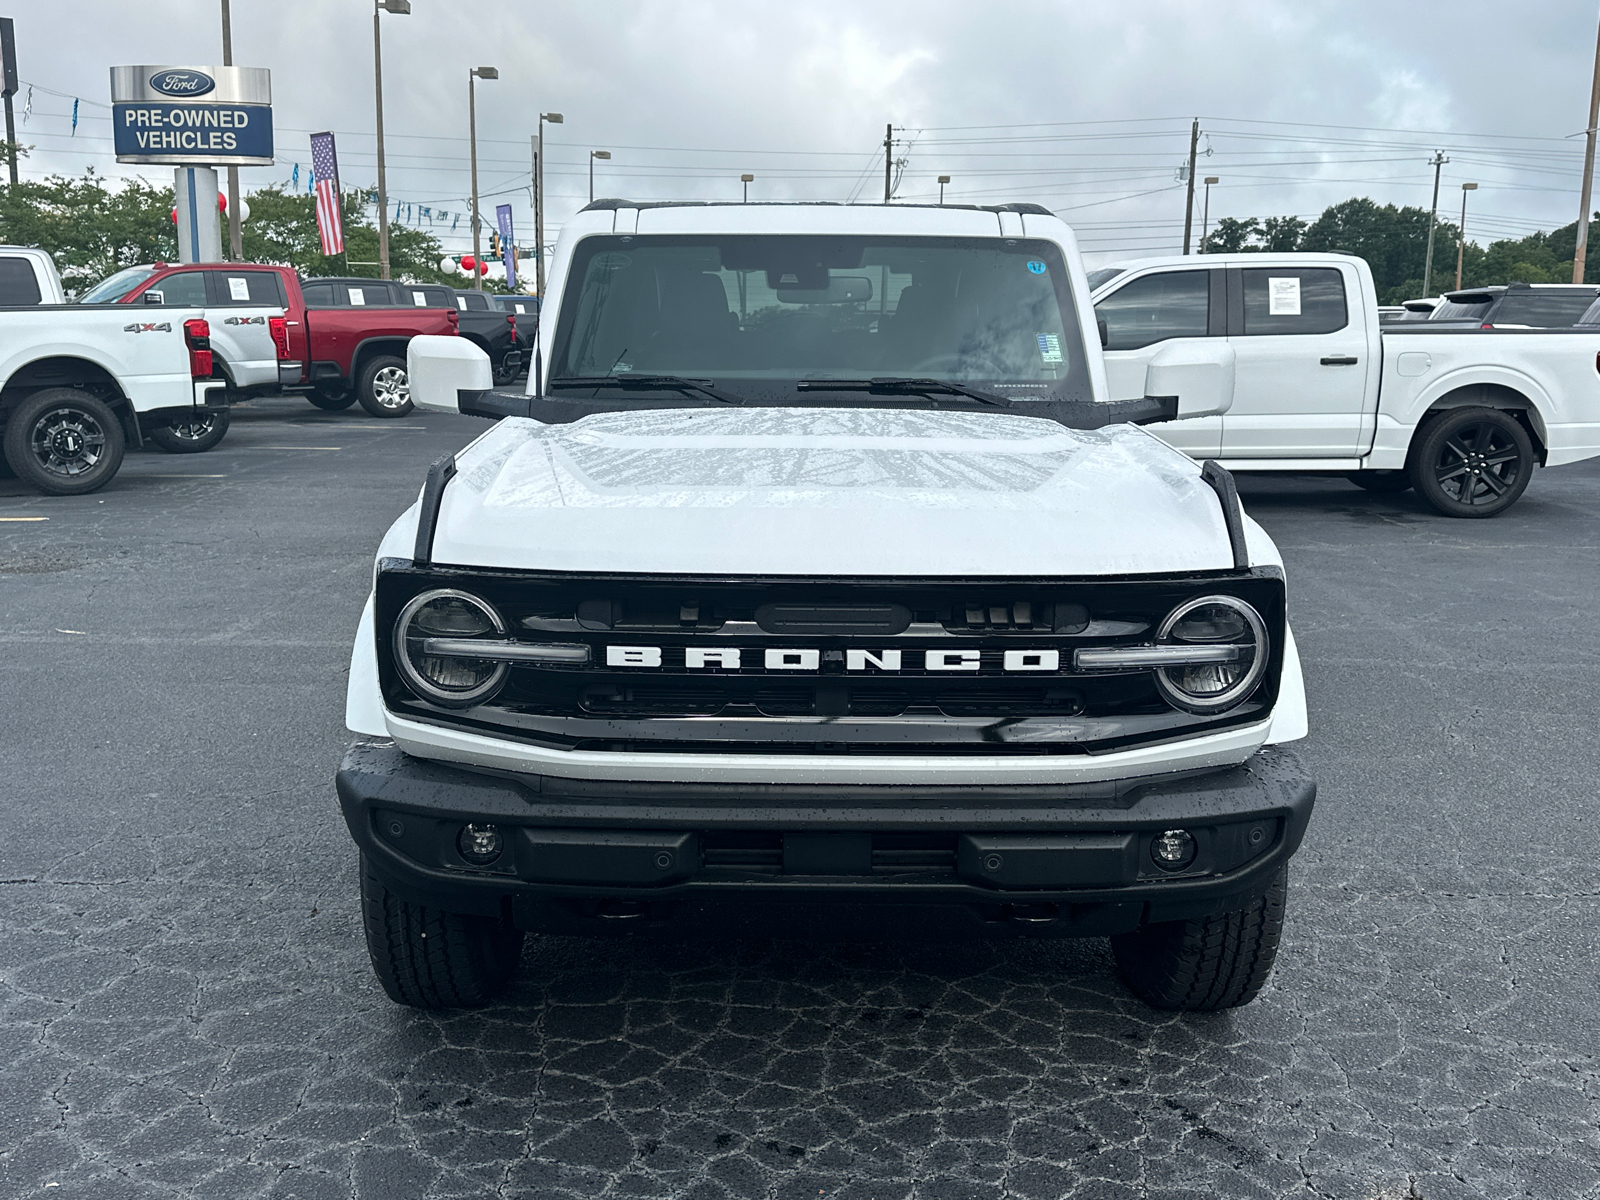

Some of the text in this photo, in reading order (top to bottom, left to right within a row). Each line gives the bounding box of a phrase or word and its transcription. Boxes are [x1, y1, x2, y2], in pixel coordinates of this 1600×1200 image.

[162, 74, 198, 91] Ford
[125, 109, 249, 128] PRE-OWNED
[136, 131, 237, 150] VEHICLES
[606, 645, 1060, 671] BRONCO
